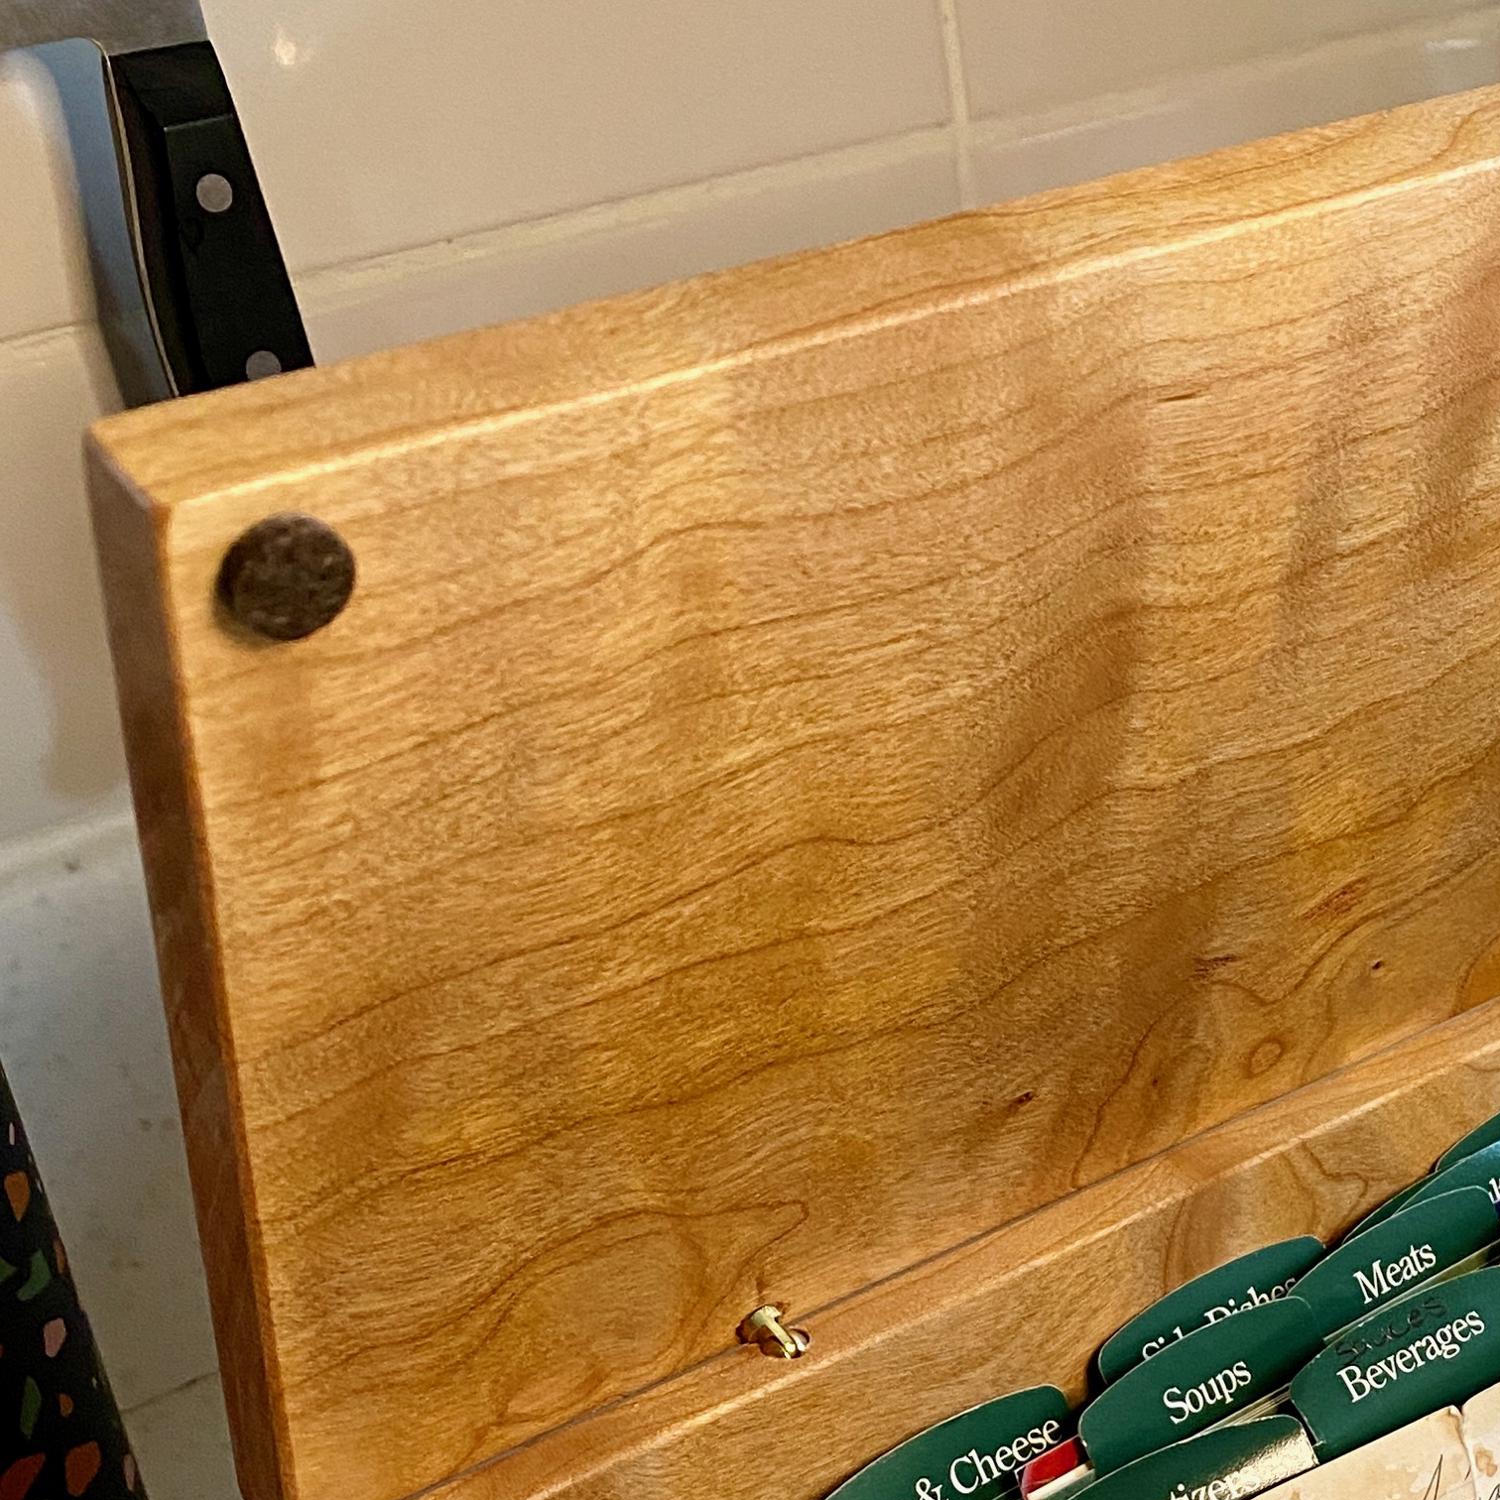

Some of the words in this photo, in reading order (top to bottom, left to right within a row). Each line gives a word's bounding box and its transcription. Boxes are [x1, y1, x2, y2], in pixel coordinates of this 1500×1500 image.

[1353, 1239, 1437, 1305] Meats
[1161, 1358, 1253, 1426] Soups
[1337, 1307, 1486, 1403] Beverages
[949, 1414, 1063, 1494] Cheese
